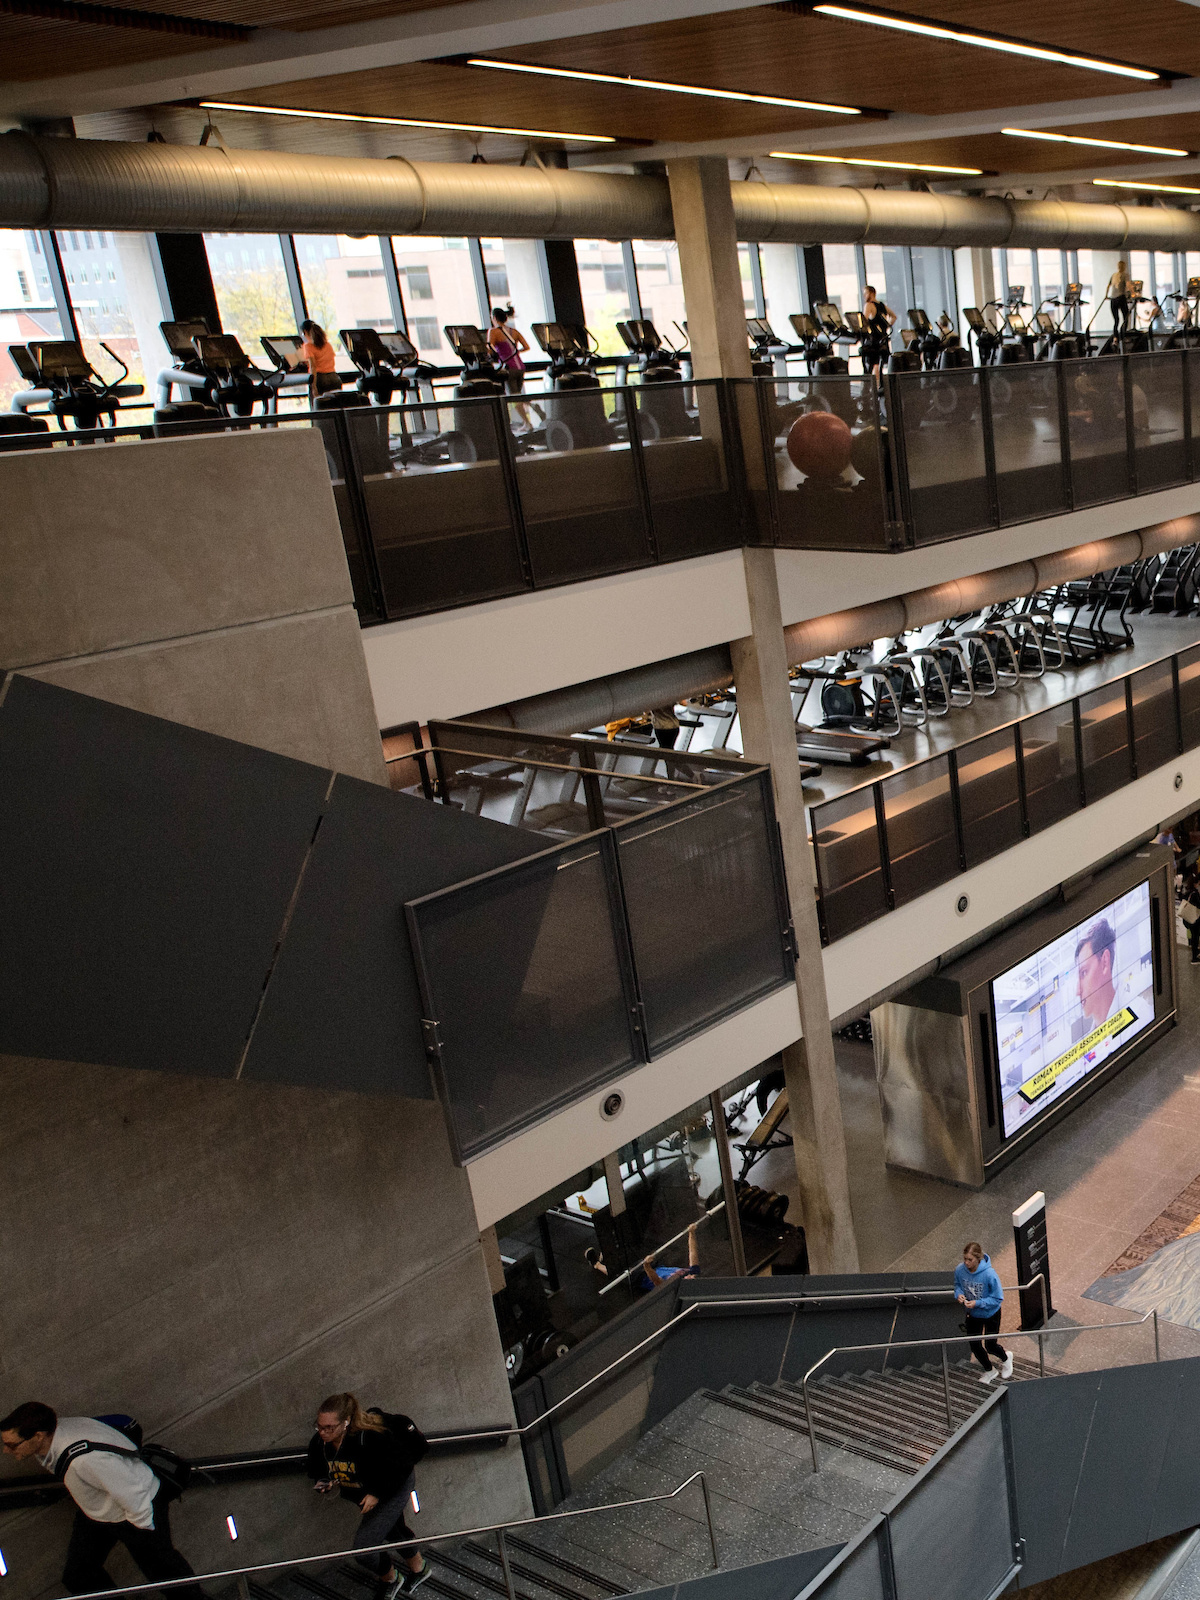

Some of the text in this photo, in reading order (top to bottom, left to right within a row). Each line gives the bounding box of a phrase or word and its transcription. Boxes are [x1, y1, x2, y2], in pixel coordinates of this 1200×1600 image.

[1033, 1067, 1053, 1087] ROMAN
[1079, 1023, 1107, 1051] ASSISTANT
[1107, 1011, 1123, 1029] COACH
